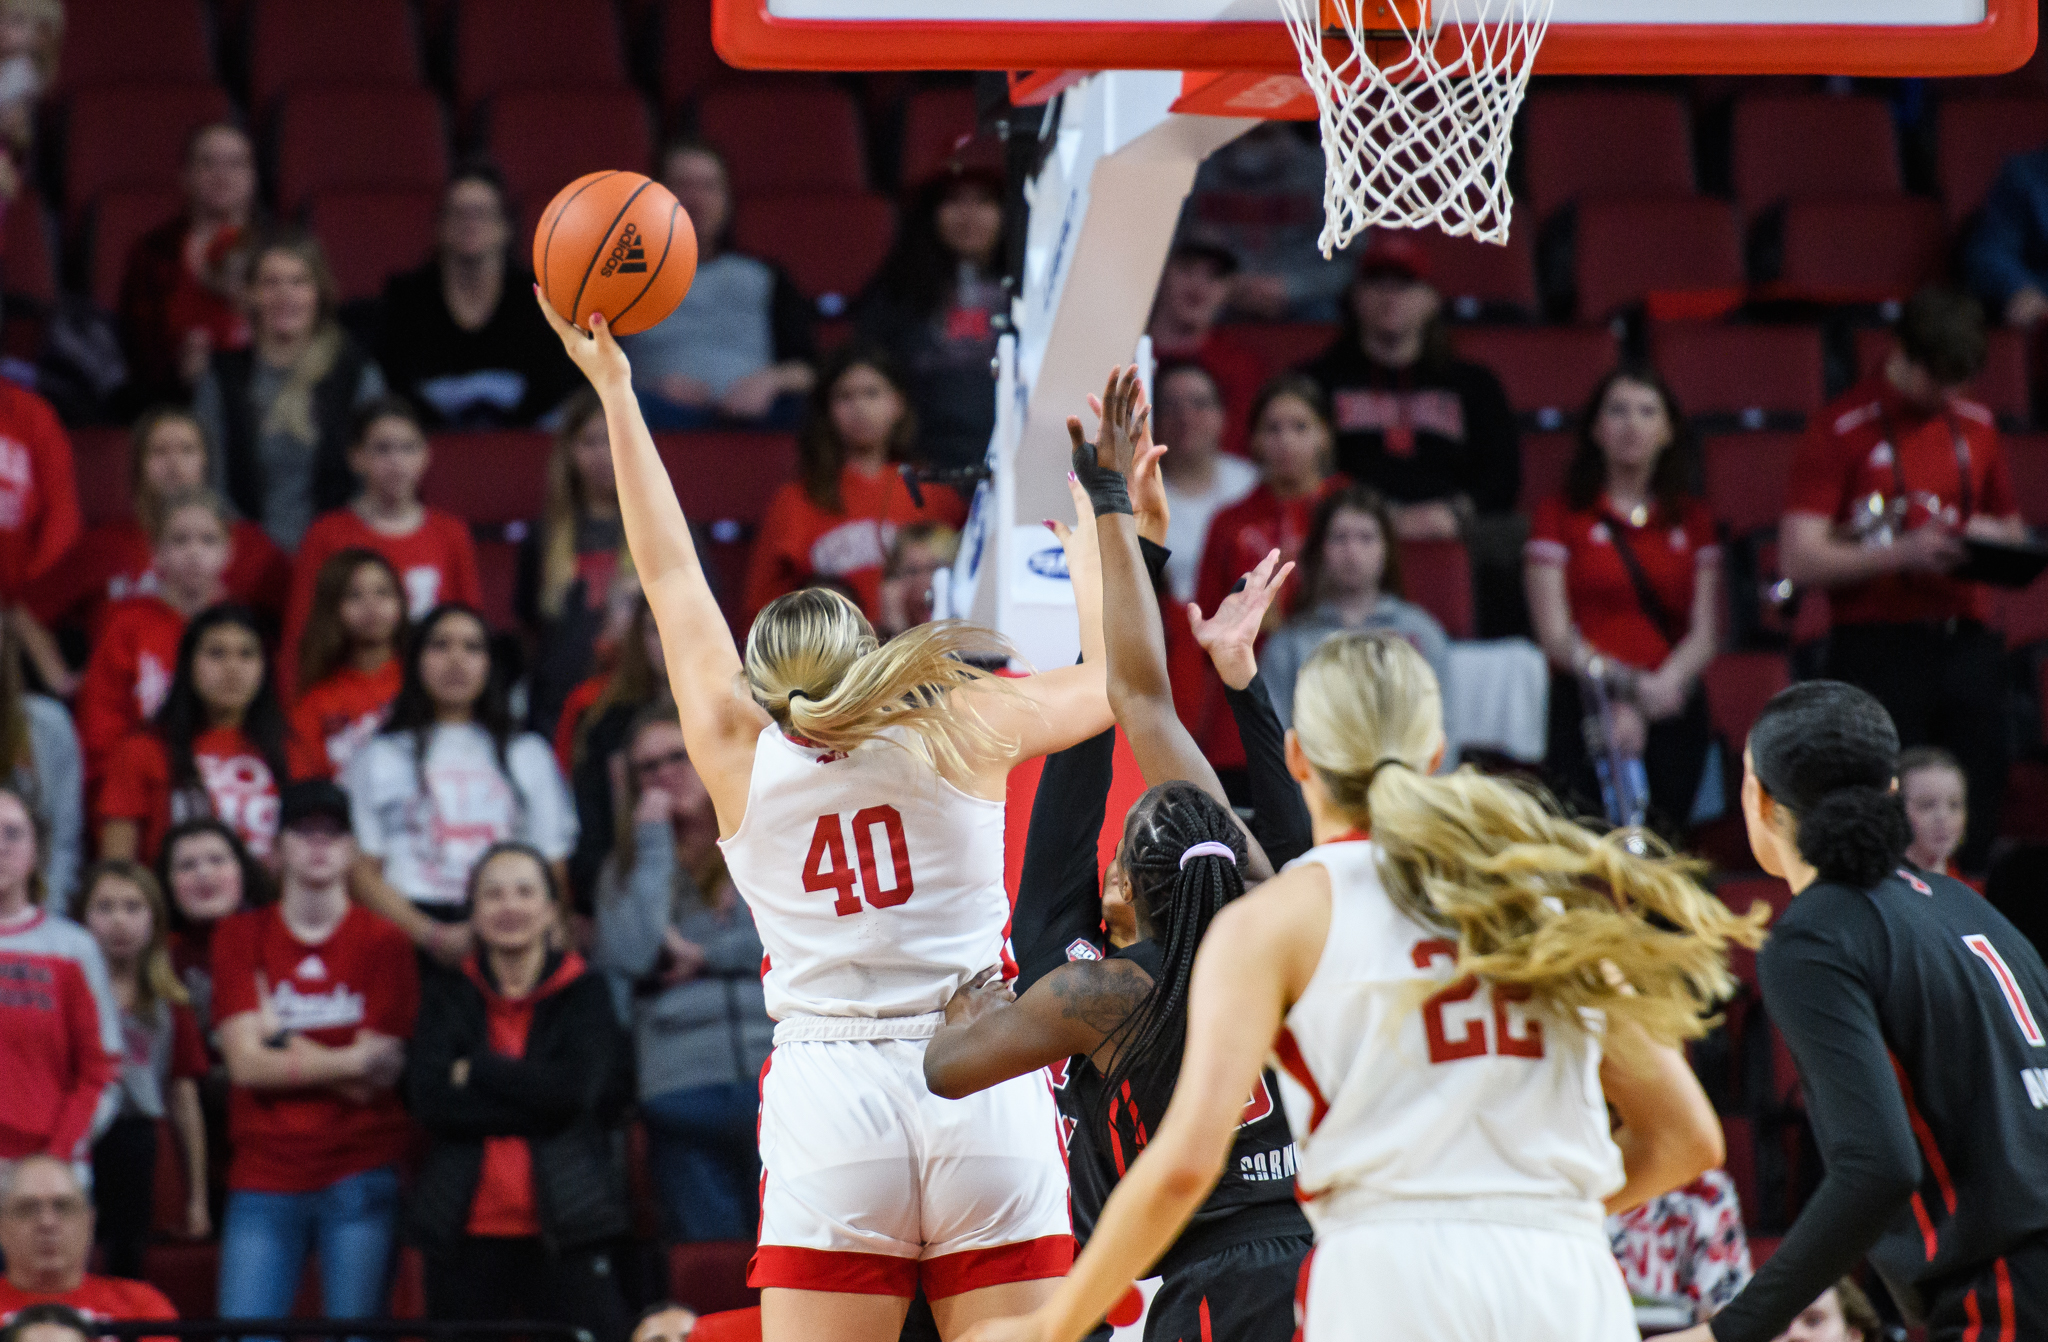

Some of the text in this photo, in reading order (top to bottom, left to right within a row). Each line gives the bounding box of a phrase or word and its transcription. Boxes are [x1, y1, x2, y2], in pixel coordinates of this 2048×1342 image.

[600, 223, 637, 278] adidas
[801, 803, 915, 917] 40
[1411, 935, 1545, 1063] 22
[1961, 934, 2046, 1047] 1
